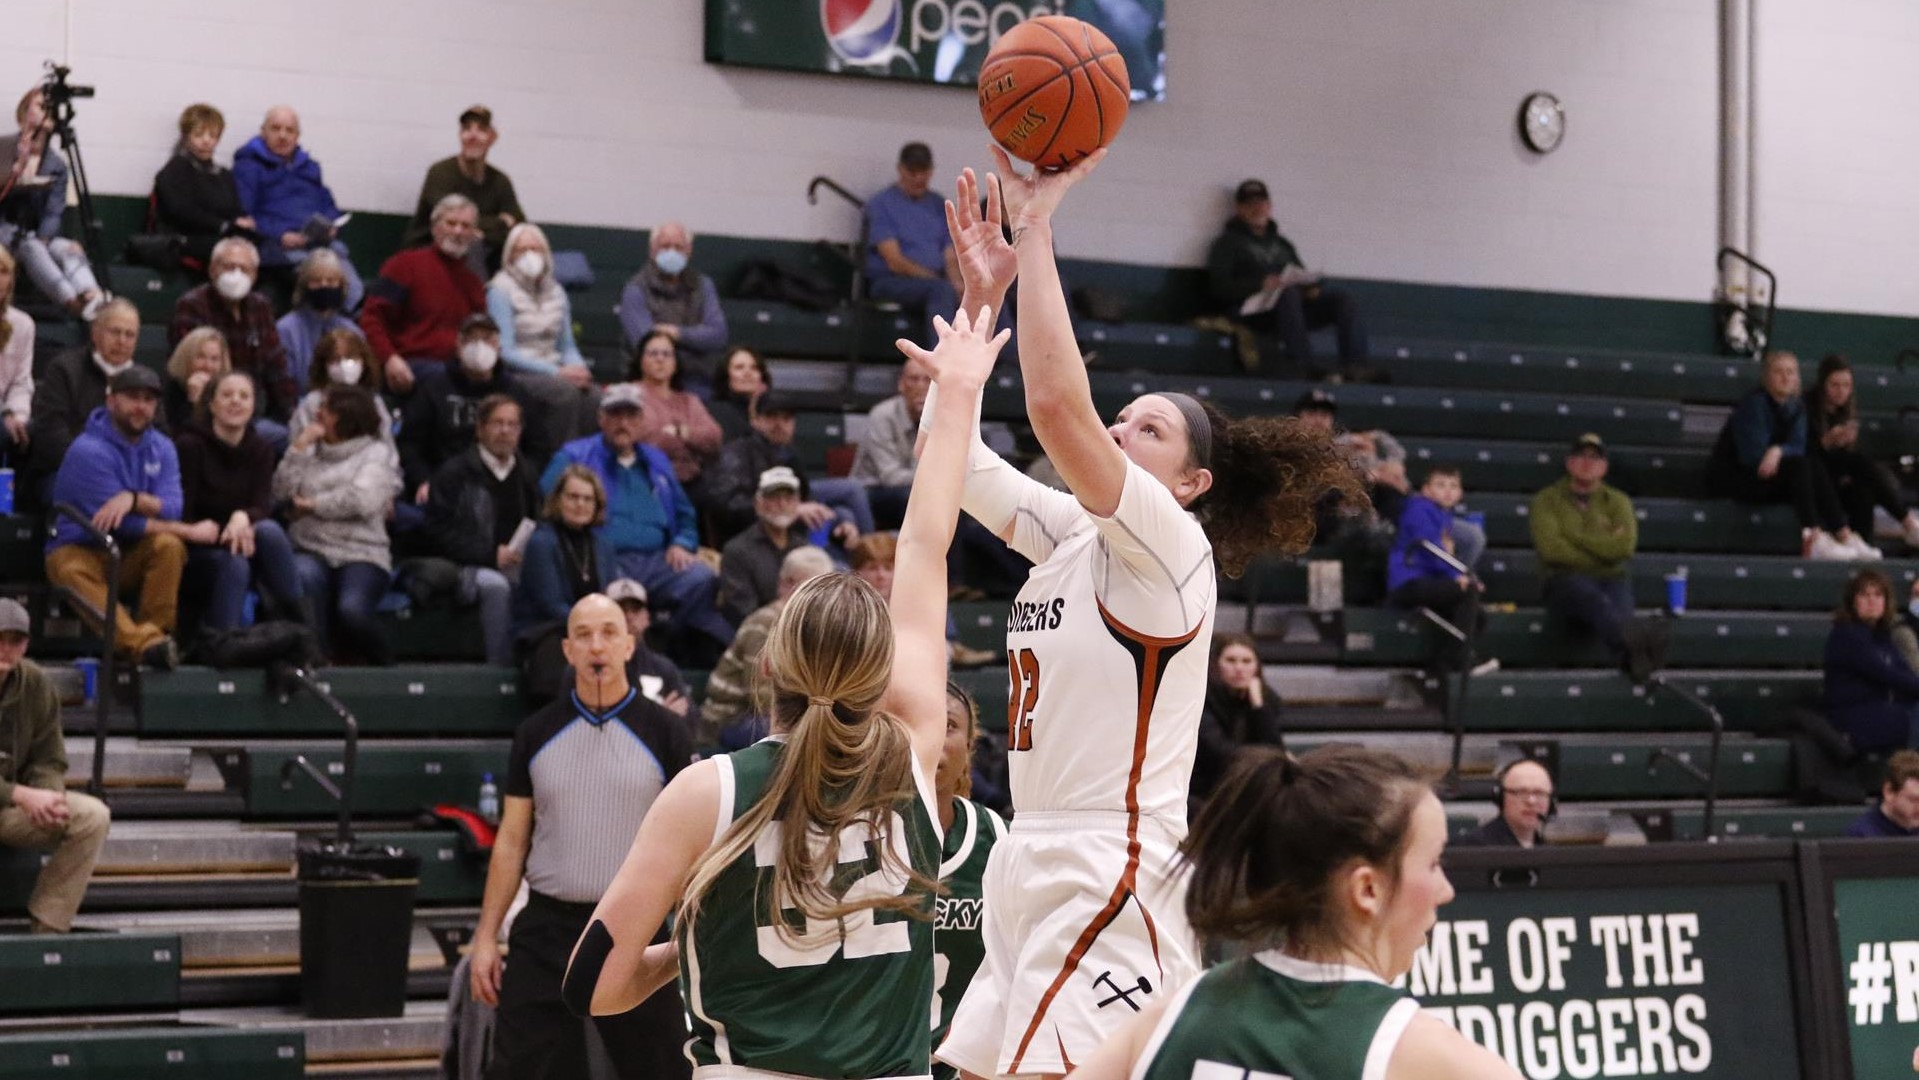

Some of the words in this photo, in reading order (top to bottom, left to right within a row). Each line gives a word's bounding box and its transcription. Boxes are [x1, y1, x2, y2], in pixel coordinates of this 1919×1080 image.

[910, 0, 1066, 54] pep
[1409, 920, 1494, 996] ME
[1506, 917, 1577, 993] OF
[1590, 912, 1704, 989] THE
[1420, 994, 1712, 1080] DIGGERS
